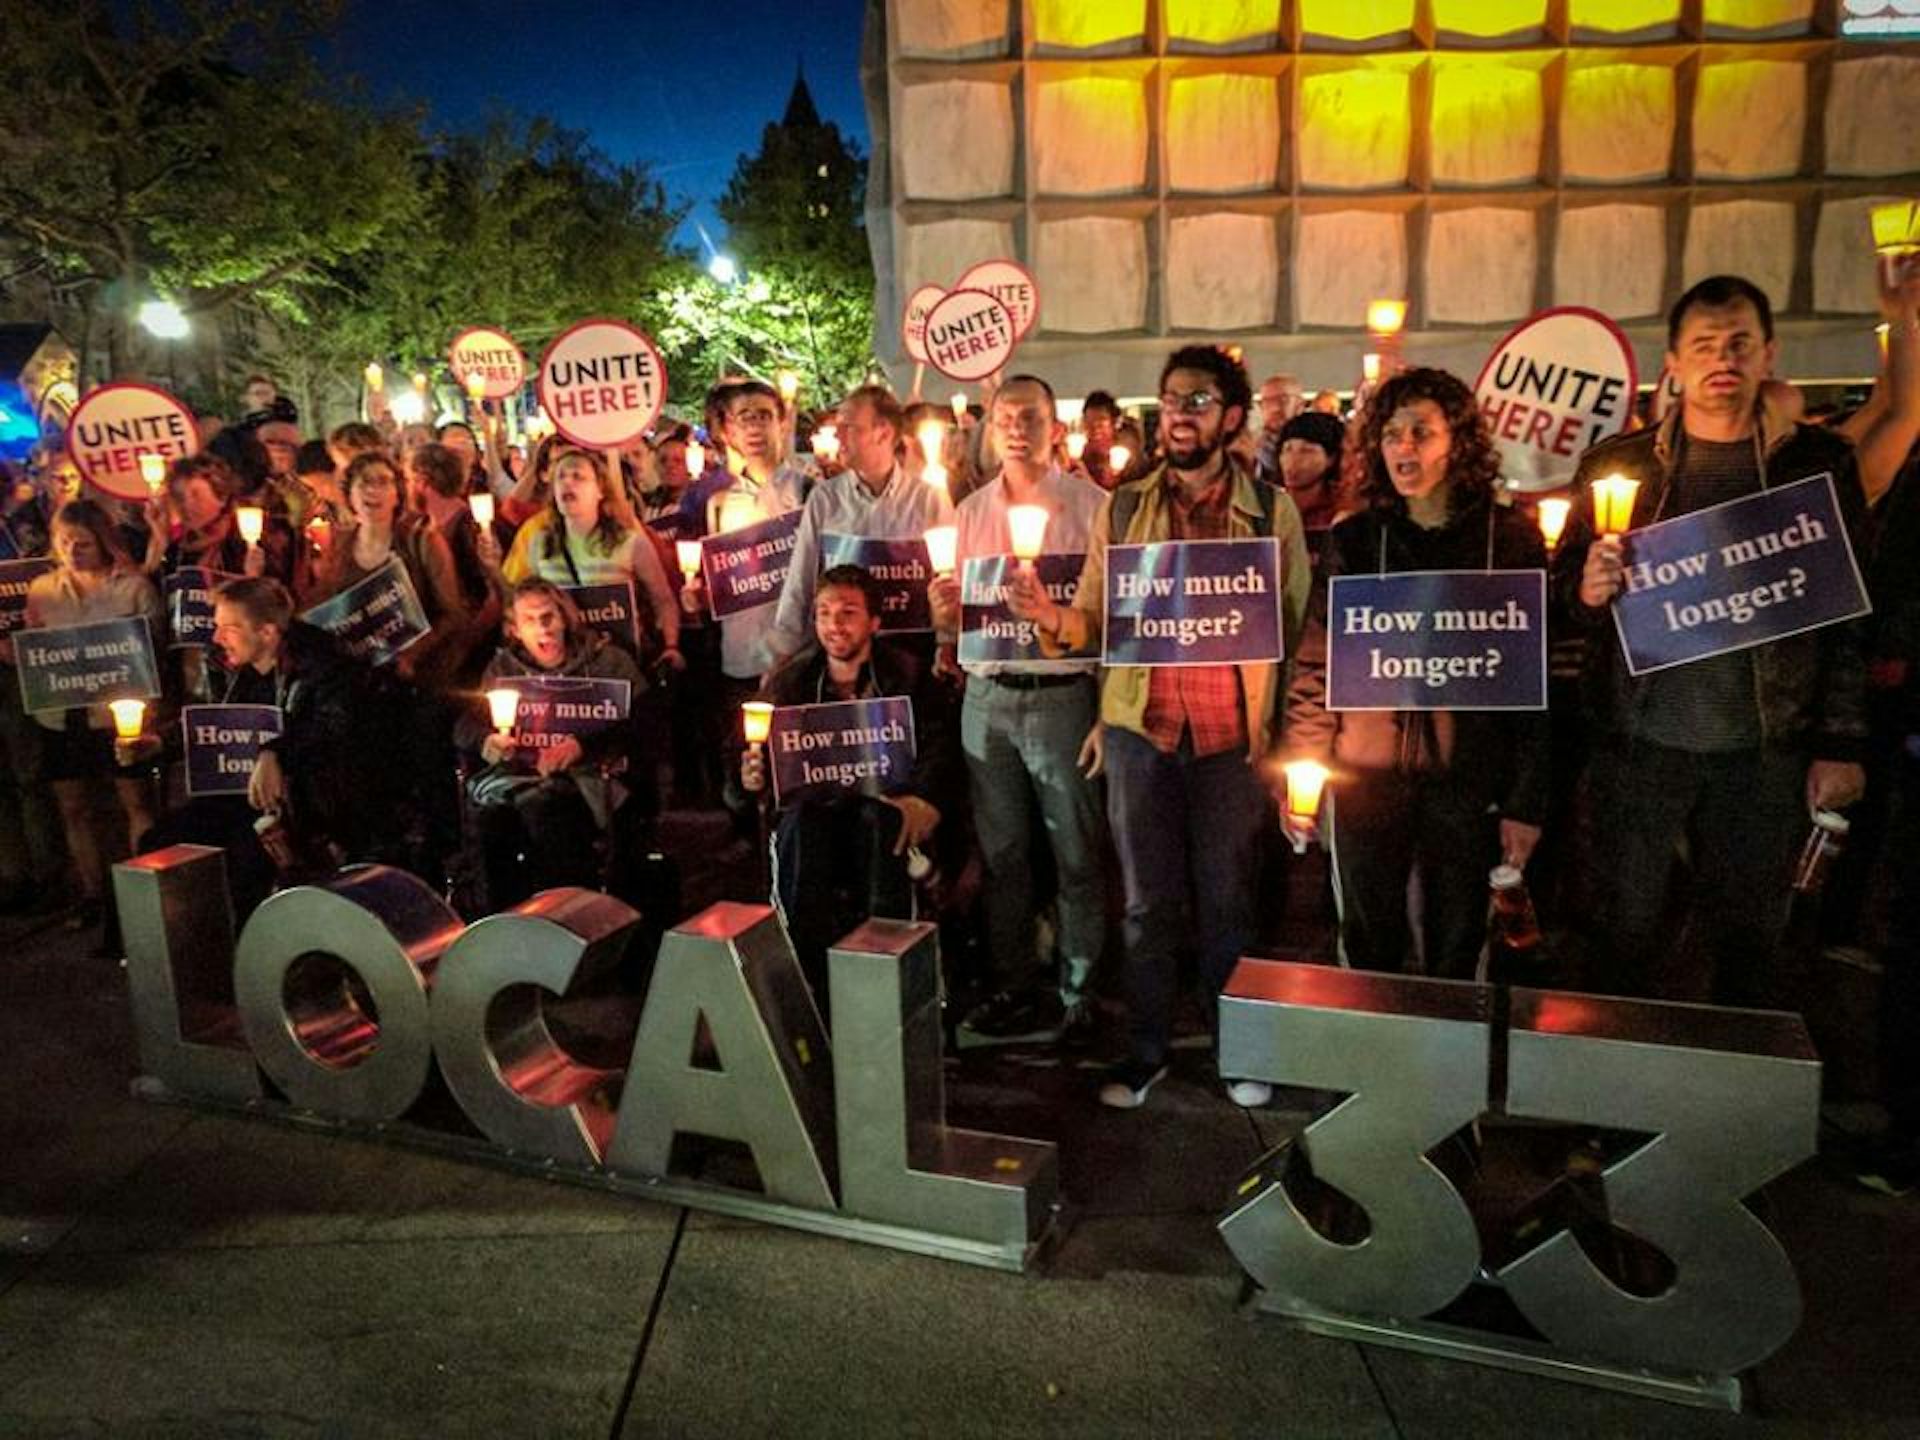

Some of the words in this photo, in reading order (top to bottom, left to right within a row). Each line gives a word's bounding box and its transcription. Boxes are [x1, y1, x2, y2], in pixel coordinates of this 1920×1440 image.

[989, 283, 1031, 302] ITE
[929, 304, 1003, 345] UNITE
[458, 350, 516, 364] UNITE
[936, 326, 1009, 366] HERE!
[550, 352, 652, 387] UNITE
[1494, 352, 1626, 417] UNITE
[554, 382, 653, 419] HERE!
[78, 412, 185, 447] UNITE
[712, 548, 752, 573] How
[1623, 552, 1710, 595] How
[1720, 513, 1828, 568] much
[730, 566, 789, 596] longer
[1116, 573, 1175, 598] How
[1183, 566, 1267, 596] much
[1662, 567, 1807, 632] longer?
[981, 614, 1040, 646] long
[1133, 611, 1244, 646] longer?
[1343, 606, 1422, 635] How
[1434, 600, 1530, 633] much
[27, 646, 78, 667] How
[85, 634, 144, 660] much
[1369, 648, 1503, 686] longer?
[48, 664, 130, 692] longer?
[517, 701, 550, 716] ow
[555, 698, 618, 720] much
[195, 725, 254, 745] How
[780, 729, 835, 753] How
[841, 718, 906, 747] much
[802, 754, 891, 787] longer?
[112, 845, 1057, 1256] LOCAL
[1217, 960, 1822, 1377] 33
